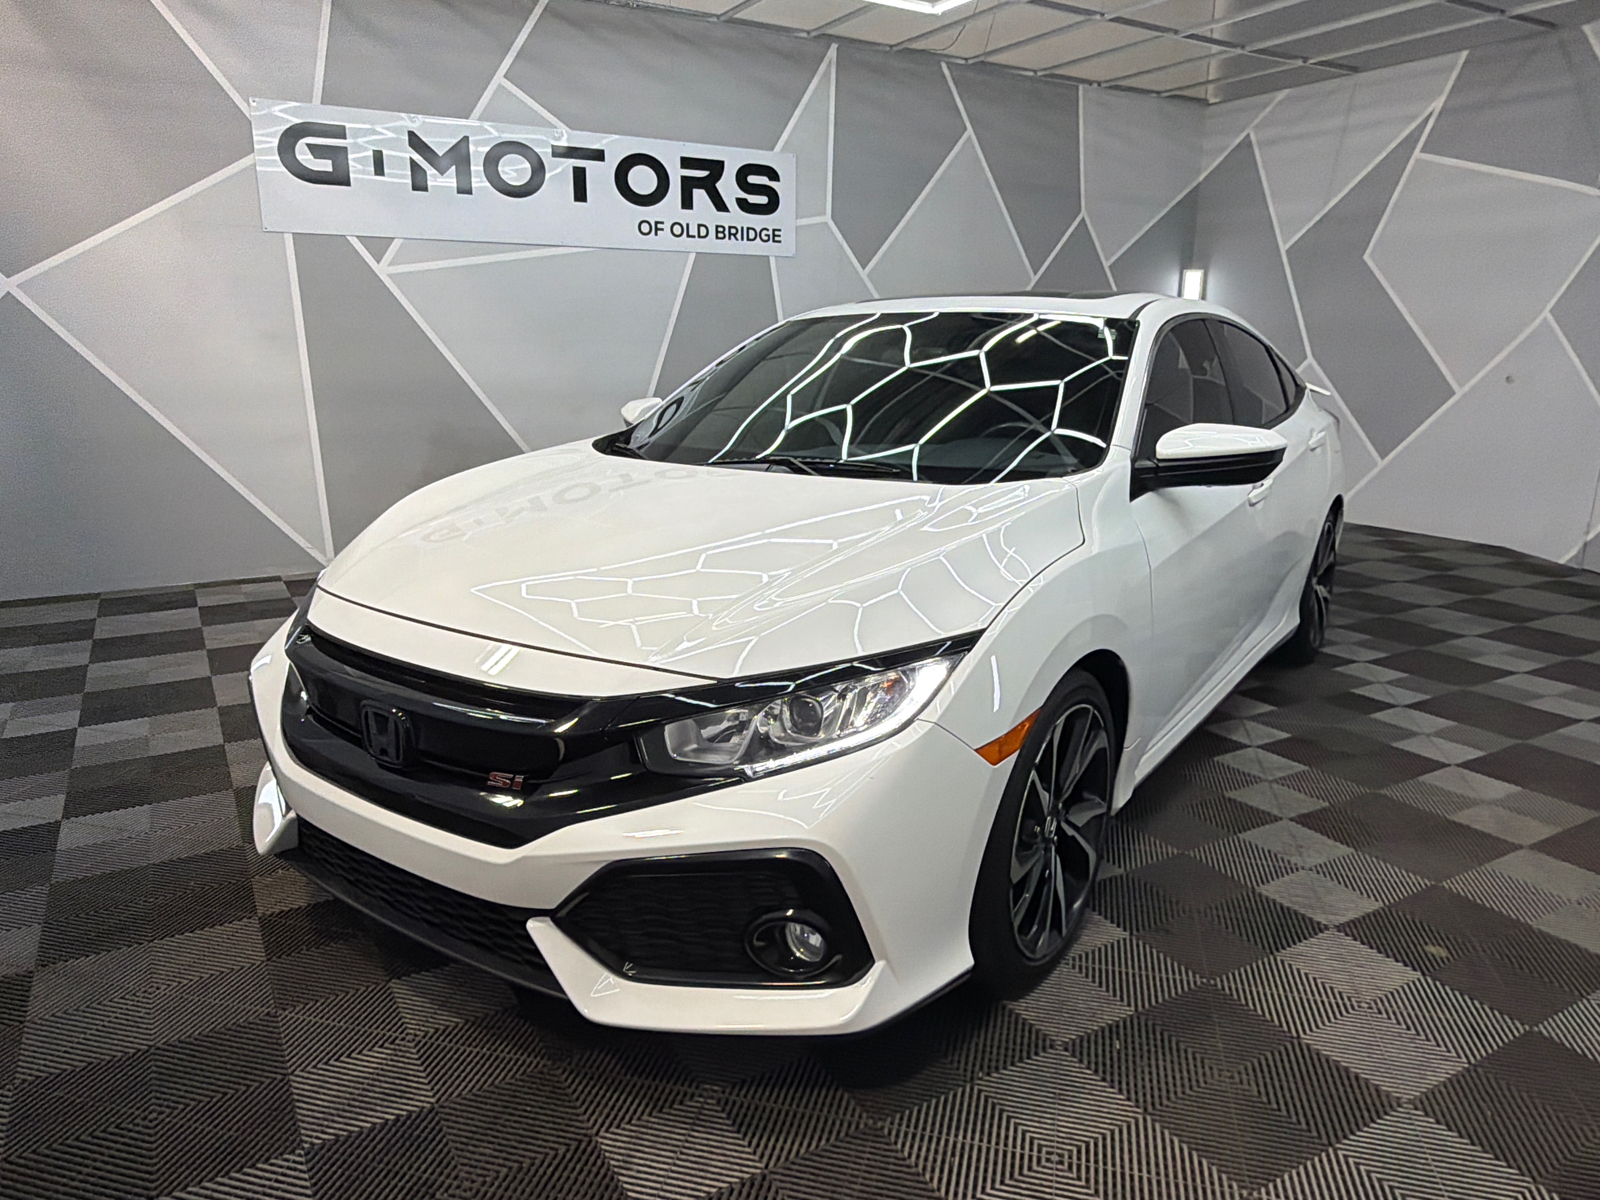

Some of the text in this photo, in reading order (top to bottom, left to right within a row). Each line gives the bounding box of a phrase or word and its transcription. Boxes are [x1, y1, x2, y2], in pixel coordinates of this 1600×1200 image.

[637, 219, 782, 244] OF OLD BRIDGE
